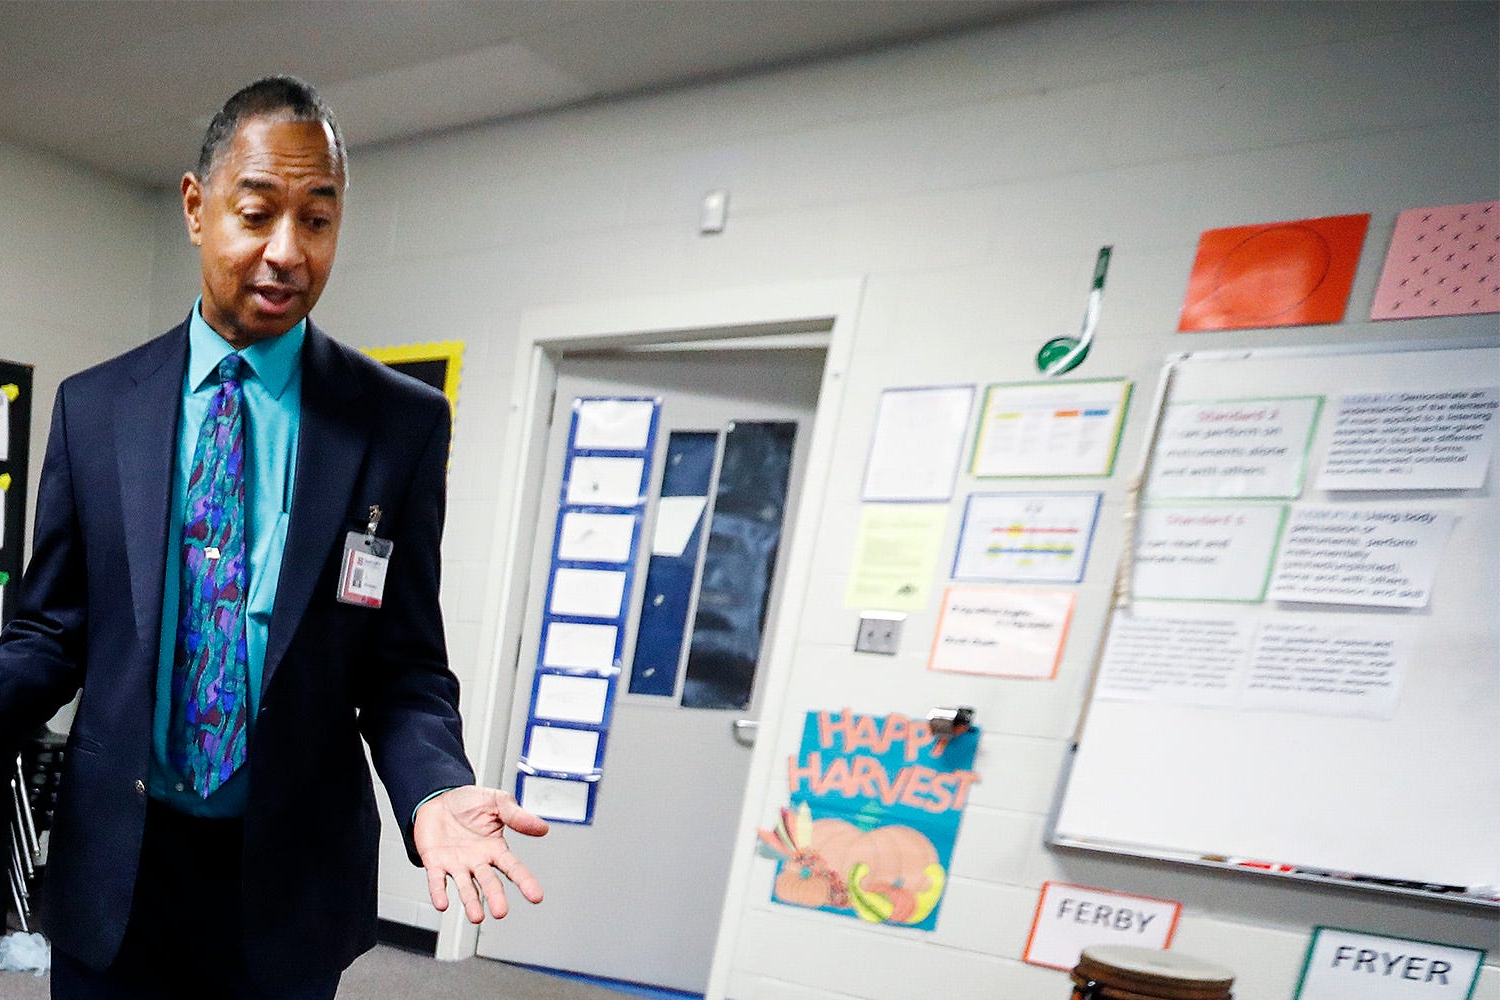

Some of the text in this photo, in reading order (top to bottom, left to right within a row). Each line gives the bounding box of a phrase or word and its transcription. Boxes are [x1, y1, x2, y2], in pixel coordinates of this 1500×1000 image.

[788, 752, 982, 813] HARVEST
[1056, 897, 1157, 934] FERBY
[1331, 945, 1453, 986] FRYER
